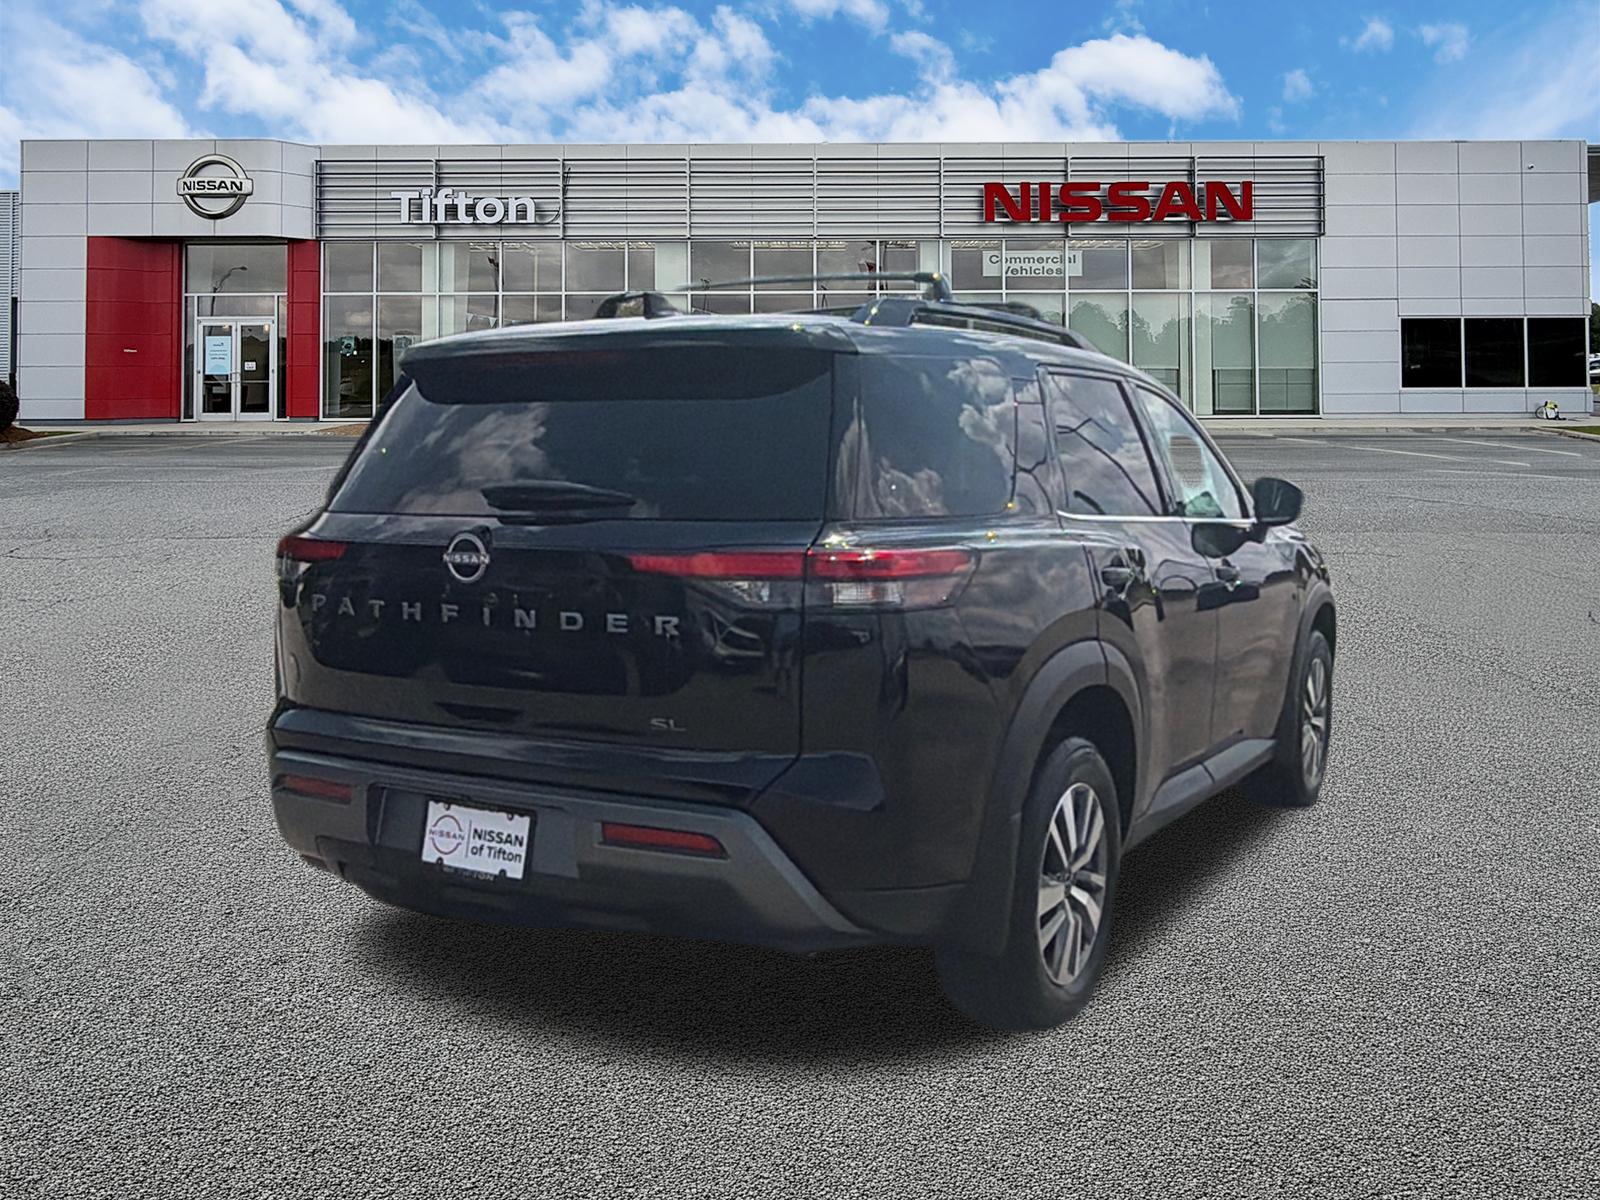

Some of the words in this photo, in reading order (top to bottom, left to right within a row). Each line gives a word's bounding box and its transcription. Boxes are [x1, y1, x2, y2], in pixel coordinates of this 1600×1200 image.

[183, 180, 243, 191] NISSAN
[391, 188, 536, 224] Tifton
[983, 180, 1253, 222] NISSAN
[443, 552, 490, 565] NISSAN
[312, 593, 680, 636] PATHFINDER
[650, 718, 687, 731] SL
[428, 829, 465, 842] NISSAN
[472, 828, 525, 848] NISSAN
[470, 844, 485, 856] of
[486, 846, 523, 863] Tifton
